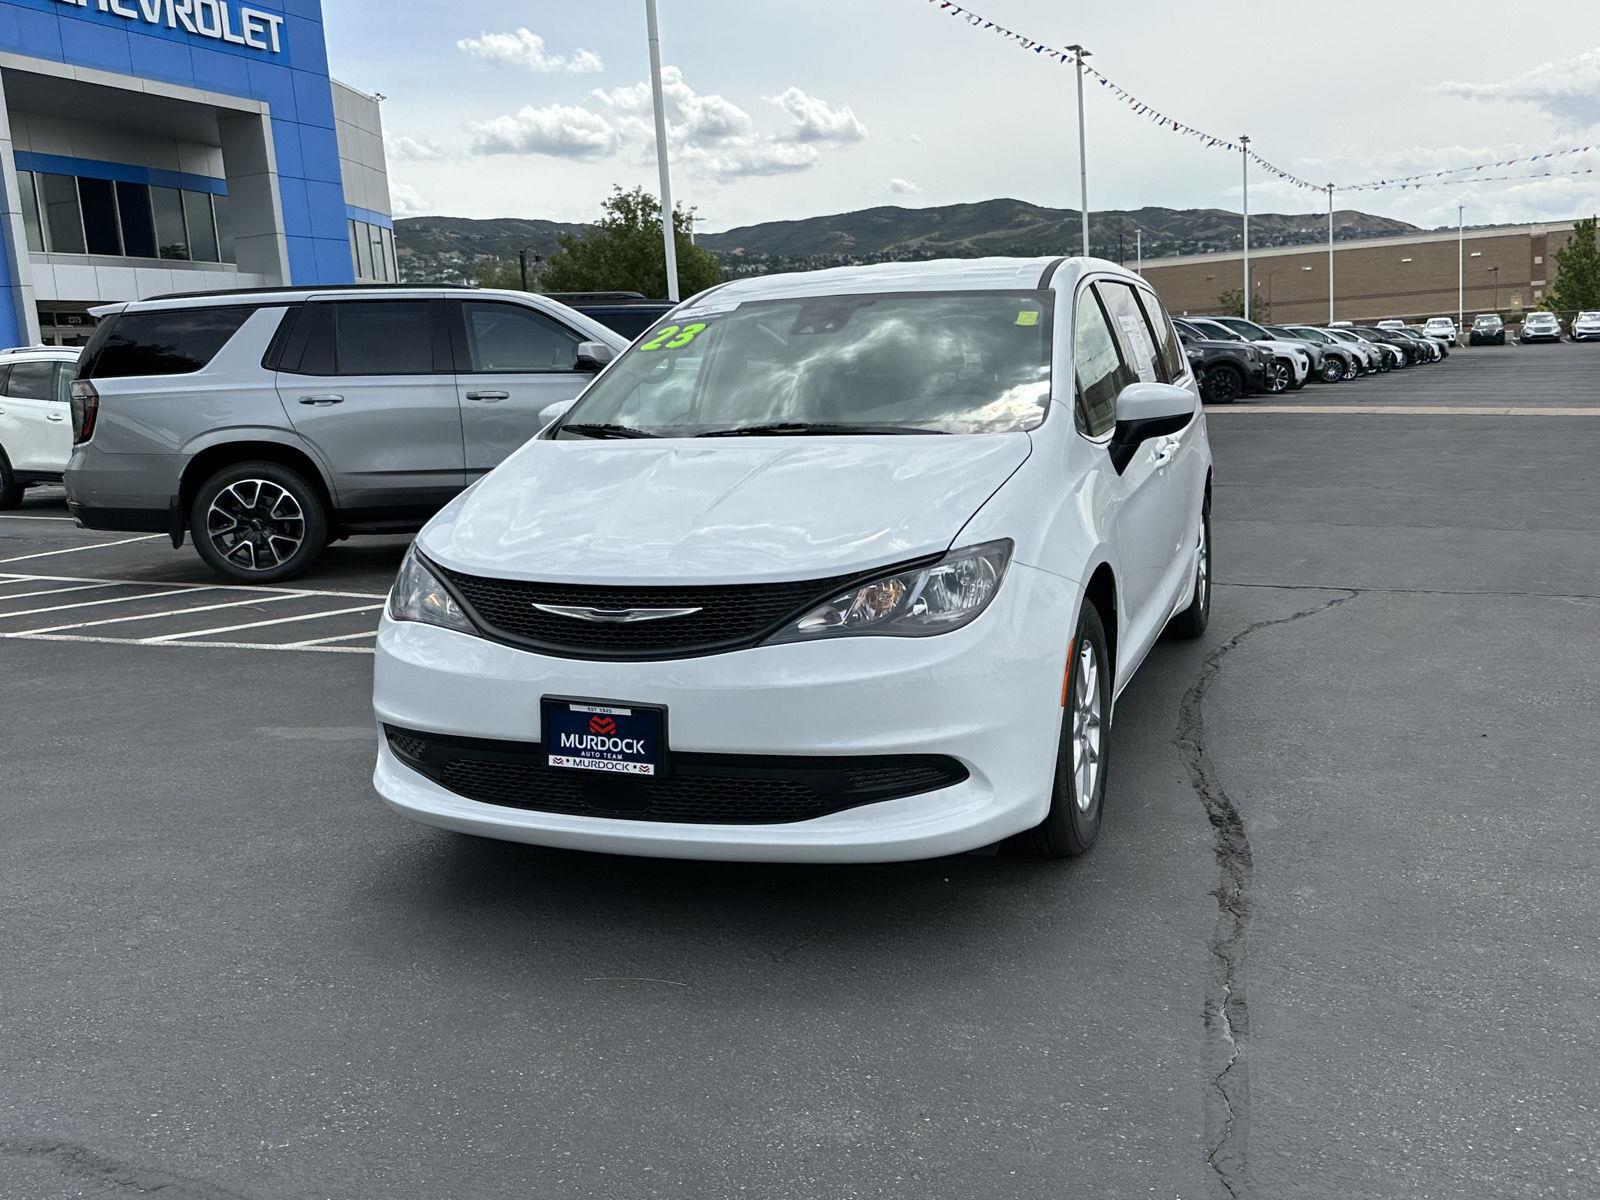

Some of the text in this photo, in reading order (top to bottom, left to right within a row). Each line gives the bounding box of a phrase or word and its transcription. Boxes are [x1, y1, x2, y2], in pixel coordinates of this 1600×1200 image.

[62, 0, 284, 53] VROLET
[640, 323, 706, 351] 23
[561, 732, 645, 755] MURDOCK
[581, 750, 623, 760] AUTO TEAM
[573, 758, 630, 772] MURDOCK
